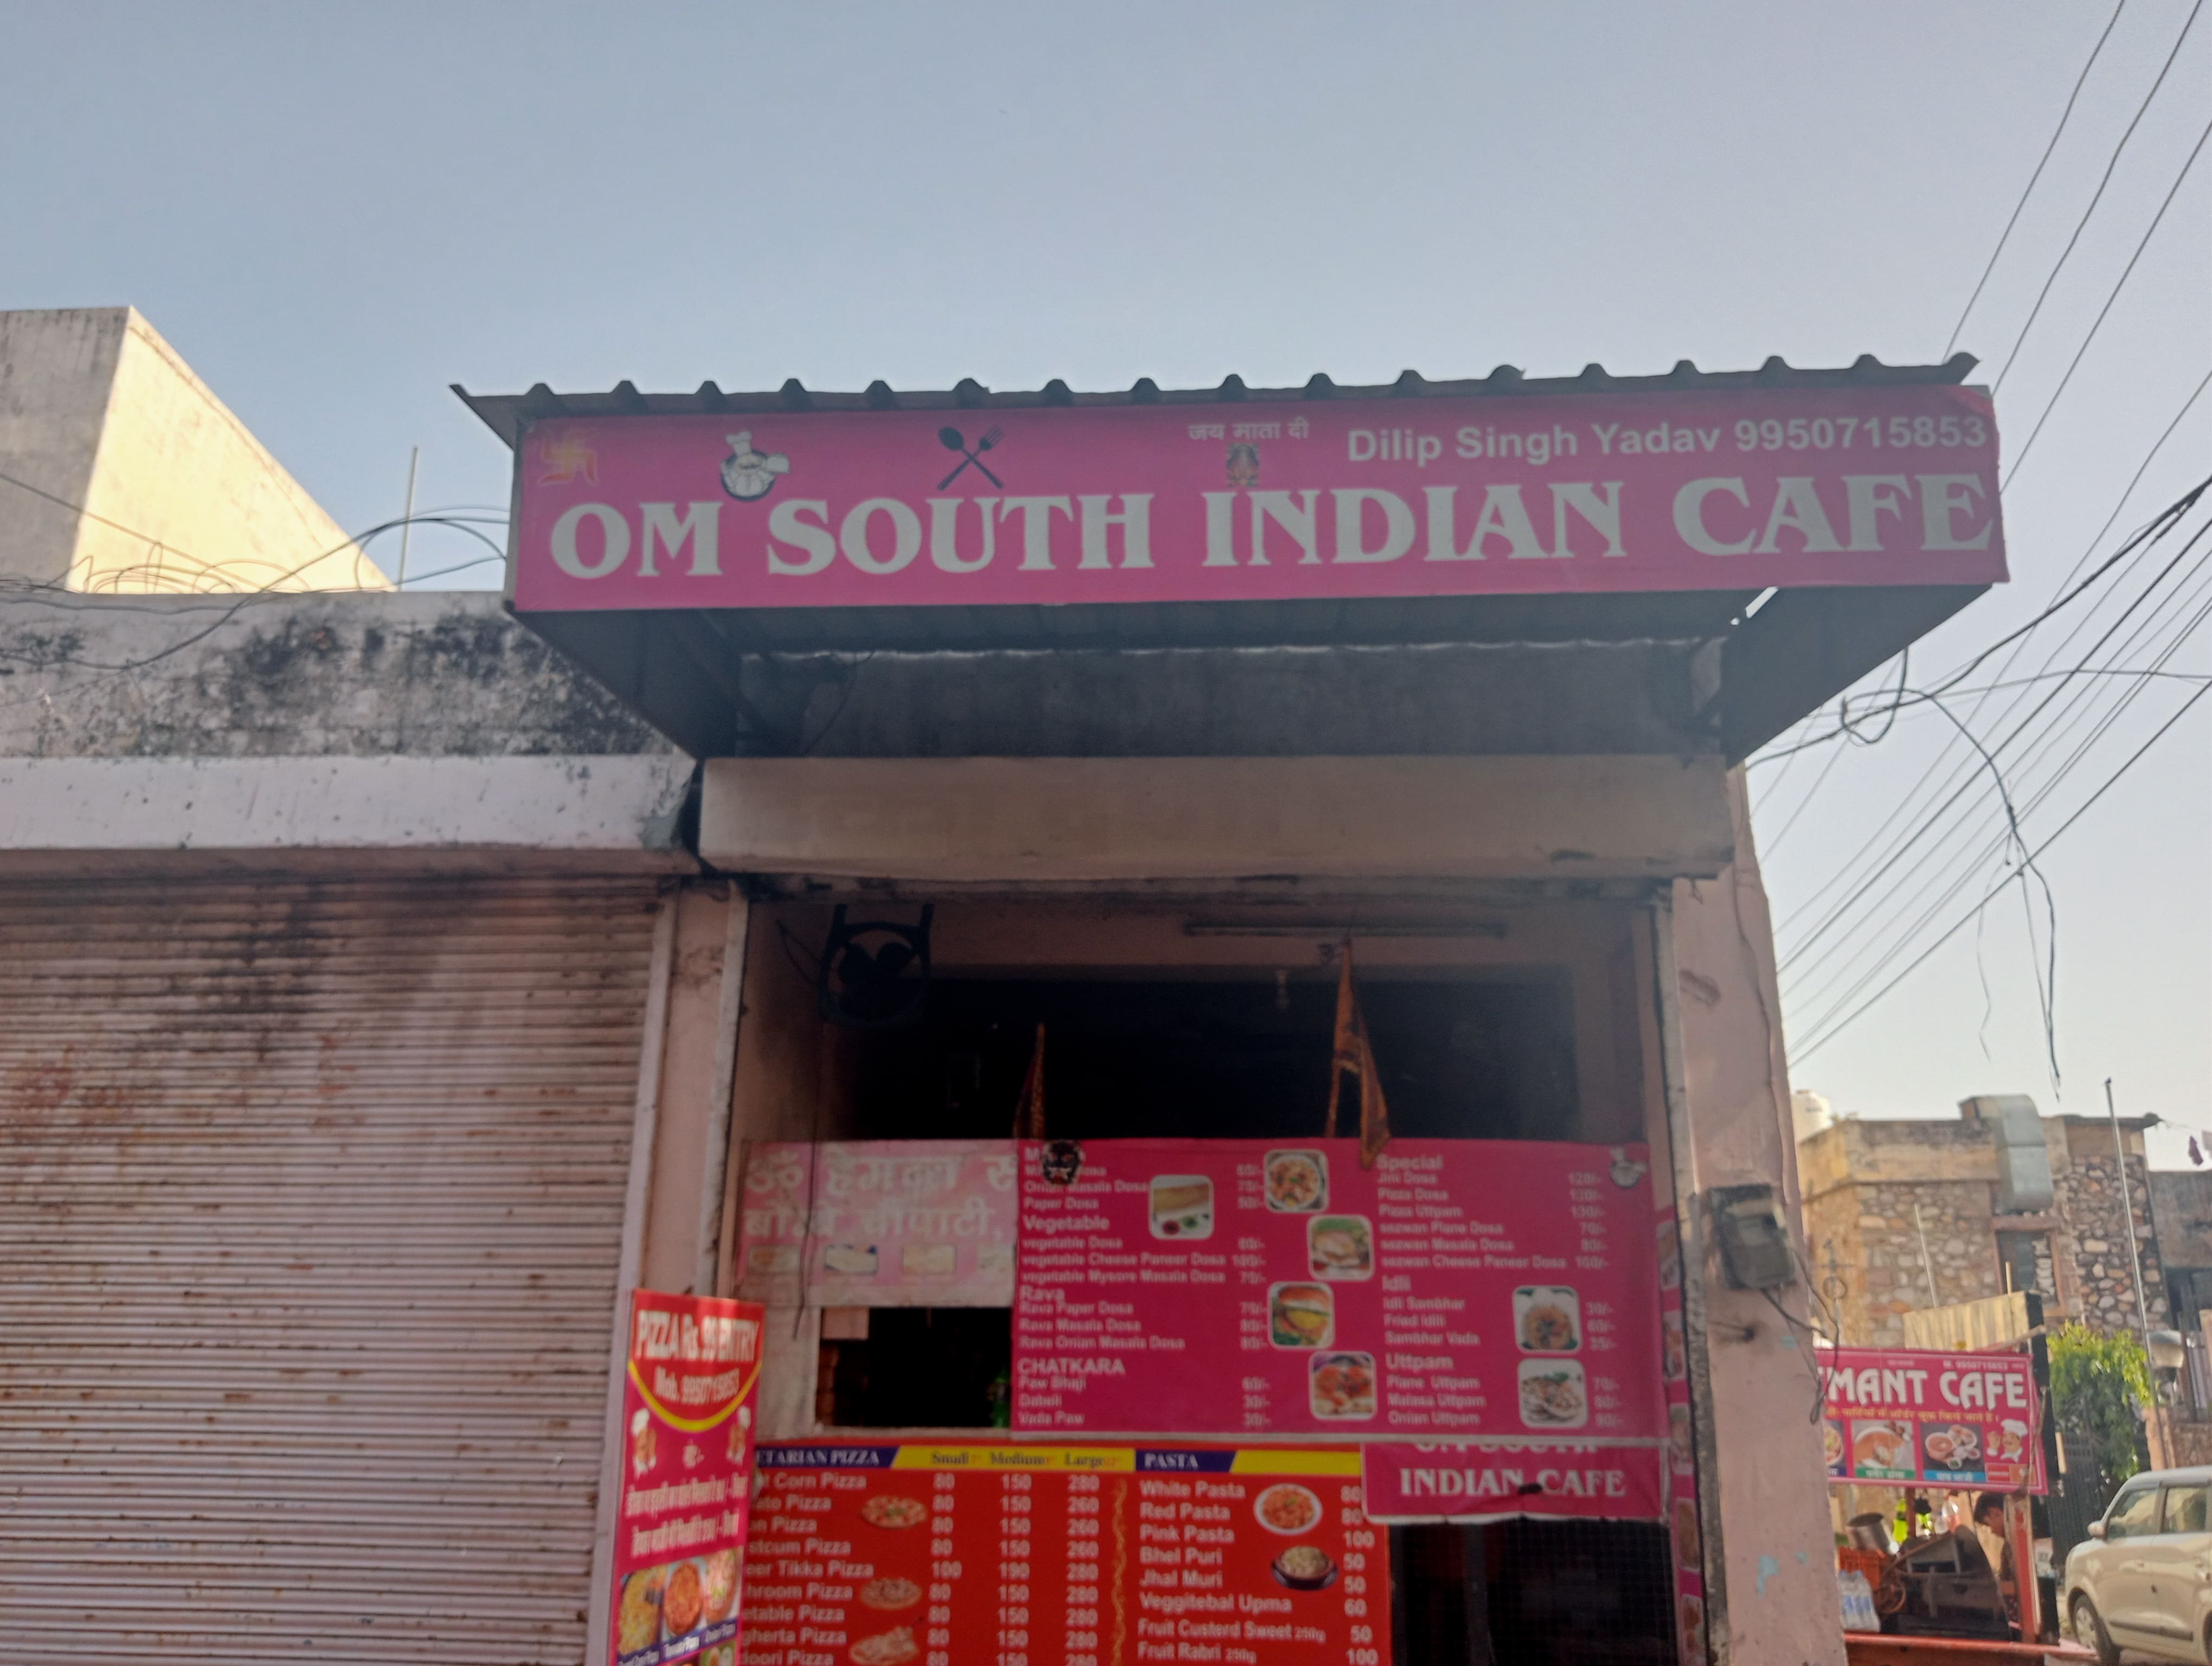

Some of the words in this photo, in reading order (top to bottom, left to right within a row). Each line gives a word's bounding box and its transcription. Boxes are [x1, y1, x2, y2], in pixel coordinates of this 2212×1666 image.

[1232, 422, 1281, 439] माता
[1288, 416, 1309, 439] दी
[1348, 429, 1442, 466] Dilip
[1456, 426, 1578, 464] Singh
[1592, 422, 1720, 455] Yadav
[1734, 417, 1986, 451] 9950715853
[550, 502, 723, 579] OM
[767, 495, 1154, 578] SOUTH
[1202, 480, 1626, 567] INDIAN
[1673, 473, 1993, 556] CAFE
[1377, 1155, 1443, 1171] Special
[1404, 1172, 1437, 1184] Dosa
[1378, 1188, 1413, 1200] Pizza
[1415, 1189, 1449, 1201] Dosa
[1024, 1197, 1062, 1211] Paper
[1065, 1197, 1099, 1209] Dosa
[1379, 1204, 1413, 1217] Pizza
[1023, 1215, 1109, 1234] Vegetable
[1470, 1221, 1503, 1234] Dosa
[1089, 1236, 1123, 1248] Dosa
[1431, 1238, 1476, 1251] Masala
[1480, 1238, 1514, 1251] Dosa
[1089, 1253, 1136, 1265] Cheese
[1191, 1253, 1226, 1265] Dosa
[1433, 1255, 1481, 1268] Cheese
[1484, 1255, 1529, 1268] Paneer
[1533, 1255, 1566, 1268] Dosa
[1141, 1270, 1187, 1282] Masala
[1191, 1270, 1226, 1282] Dosa
[1020, 1285, 1065, 1300] Rava
[1020, 1303, 1053, 1314] Rava
[1099, 1302, 1133, 1314] Dosa
[1020, 1319, 1053, 1331] Rava
[1056, 1318, 1103, 1331] Masala
[1107, 1318, 1141, 1331] Dosa
[636, 1310, 679, 1359] PIZZA
[1019, 1336, 1053, 1349] Rava
[1100, 1336, 1147, 1349] Masala
[1150, 1336, 1185, 1349] Dosa
[1446, 1332, 1479, 1345] Vada
[1017, 1358, 1126, 1374] CHATKARA
[1386, 1353, 1454, 1372] Uttpam
[1822, 1367, 1928, 1406] MANT
[1939, 1372, 2027, 1410] CAFE
[1056, 1412, 1084, 1424] Paw
[830, 1450, 879, 1465] PIZZA
[932, 1452, 969, 1464] Small
[990, 1452, 1046, 1465] Medium
[1065, 1452, 1103, 1468] Large
[1144, 1453, 1199, 1468] PASTA
[774, 1472, 816, 1489] Corn
[821, 1471, 866, 1489] Pizza
[1002, 1473, 1032, 1490] 150
[1400, 1468, 1523, 1496] INDIAN
[1539, 1469, 1625, 1496] CAFE
[1140, 1481, 1191, 1497] White
[1195, 1481, 1245, 1499] Pasta
[786, 1494, 832, 1511] Pizza
[1001, 1495, 1031, 1513] 150
[1140, 1502, 1175, 1518] Red
[1181, 1502, 1230, 1520] Pasta
[771, 1516, 817, 1533] Pizza
[1342, 1508, 1363, 1524] 80
[1000, 1517, 1031, 1535] 150
[1140, 1524, 1179, 1541] Pink
[1185, 1525, 1234, 1543] Pasta
[805, 1537, 851, 1555] Pizza
[1000, 1540, 1030, 1556] 150
[1344, 1531, 1375, 1548] 100
[1140, 1547, 1180, 1564] Bhel
[1185, 1548, 1221, 1565] Puri
[1344, 1553, 1365, 1571] 50
[779, 1560, 824, 1577] Tikka
[828, 1560, 873, 1578] Pizza
[1140, 1570, 1178, 1587] Jhal
[1182, 1571, 1222, 1588] Muri
[1345, 1577, 1366, 1594] 50
[747, 1582, 802, 1598] hroom
[807, 1582, 853, 1599] Pizza
[999, 1585, 1029, 1603] 150
[1239, 1595, 1292, 1614] Upma
[1345, 1599, 1367, 1617] 60
[743, 1605, 794, 1621] etable
[799, 1605, 845, 1622] Pizza
[998, 1607, 1028, 1625] 150
[801, 1627, 847, 1645] Pizza
[1139, 1618, 1174, 1636] Fruit
[1245, 1621, 1291, 1639] Sweet
[1352, 1625, 1372, 1643] 50
[998, 1630, 1028, 1648] 150
[788, 1650, 834, 1666] Pizza
[1139, 1641, 1174, 1659] Fruit
[1179, 1642, 1220, 1661] Rabri
[1347, 1648, 1378, 1666] 100
